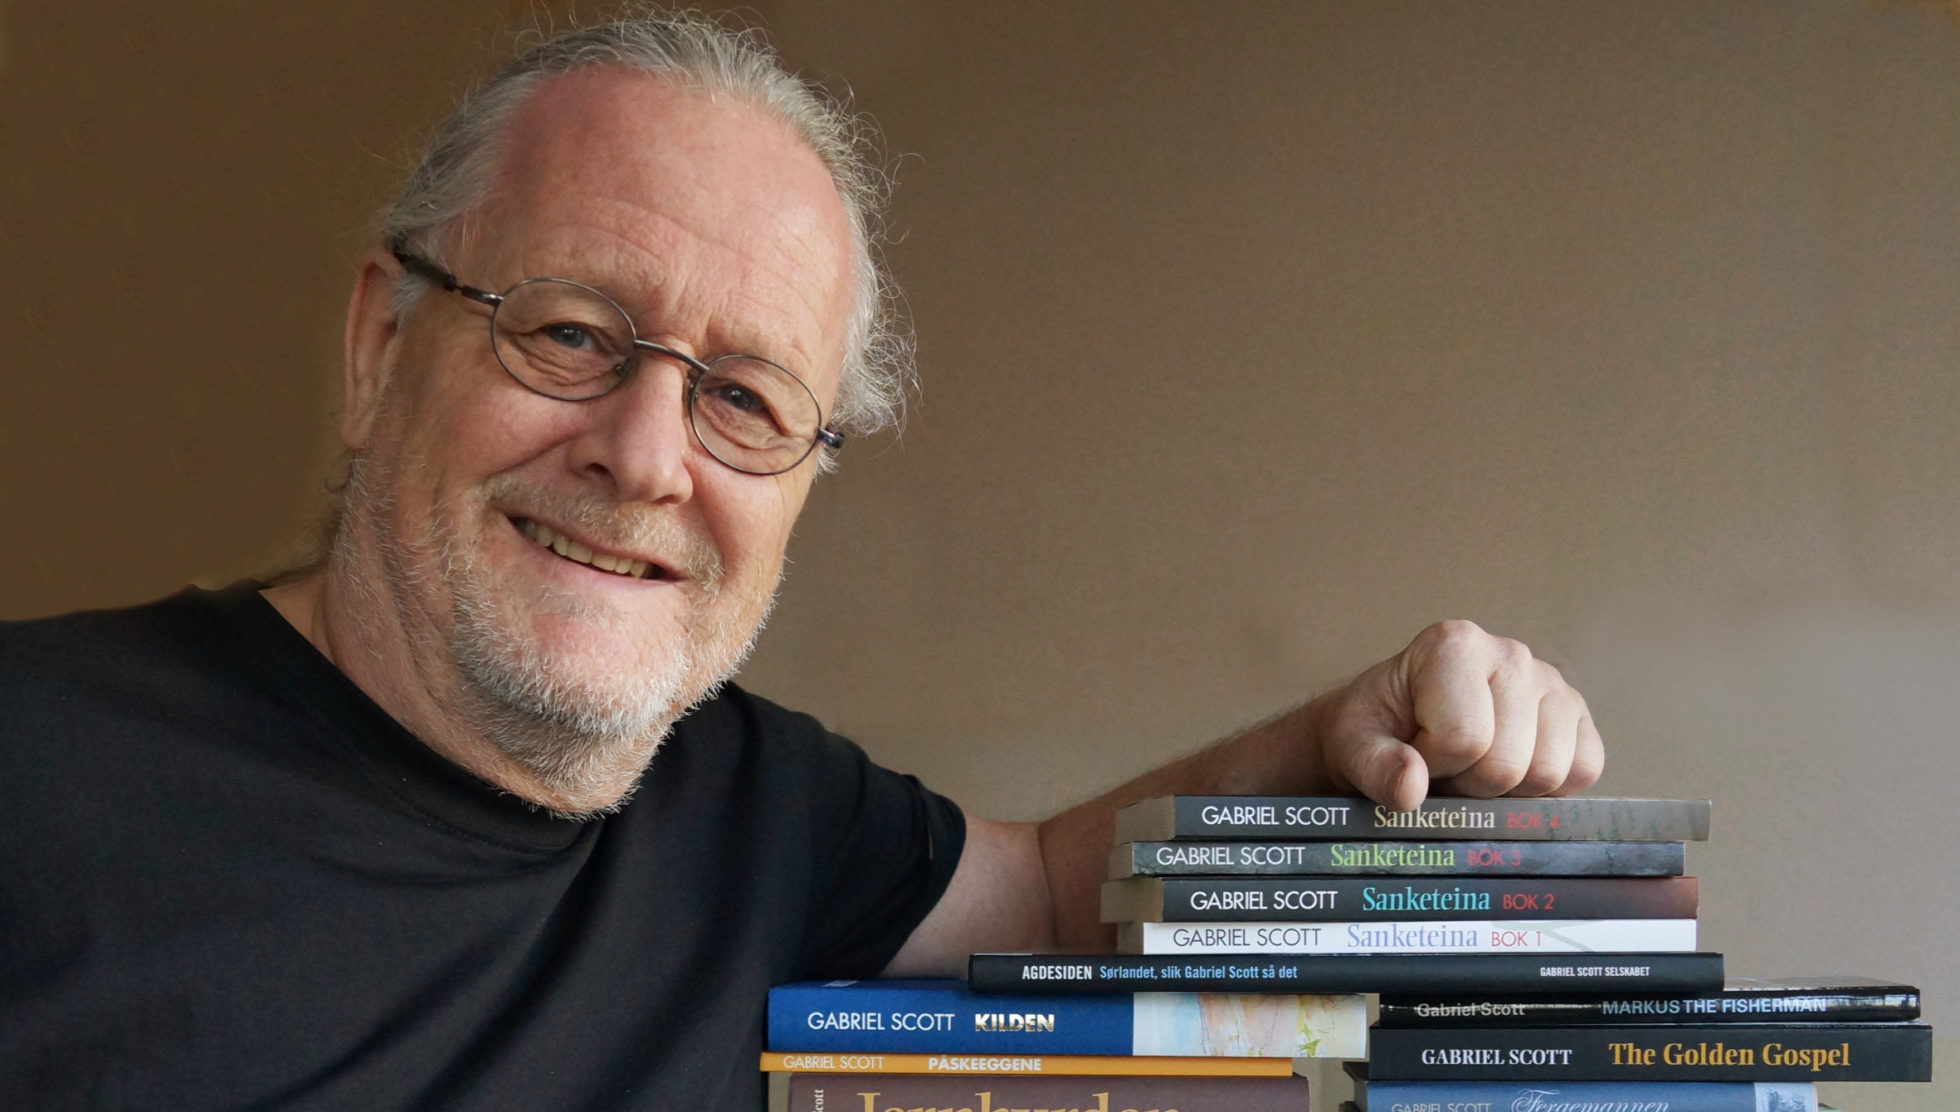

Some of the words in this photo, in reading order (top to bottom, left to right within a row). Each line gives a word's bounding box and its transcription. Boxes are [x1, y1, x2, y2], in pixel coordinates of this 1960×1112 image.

[1201, 805, 1279, 826] GABRIEL
[1285, 806, 1350, 826] SCOTT
[1374, 805, 1495, 829] Sanketeina
[1507, 812, 1543, 829] BOK
[1549, 813, 1560, 829] 4
[1156, 847, 1234, 866] GABRIEL
[1240, 846, 1305, 865] SCOTT
[1330, 843, 1455, 867] Sanketeina
[1467, 850, 1504, 867] BOK
[1511, 850, 1521, 866] 3
[1190, 891, 1268, 910] GABRIEL
[1273, 891, 1338, 910] SCOTT
[1362, 886, 1490, 911] Sanketeina
[1503, 894, 1538, 910] BOK
[1544, 894, 1555, 910] 2
[1173, 928, 1250, 947] GABRIEL
[1257, 928, 1321, 946] SCOTT
[1347, 923, 1478, 948] Sanketeina
[1491, 931, 1528, 947] BOK
[1534, 931, 1542, 947] 1
[1022, 965, 1093, 980] AGDESIDEN
[1100, 965, 1158, 981] Sørlandet,
[1161, 965, 1182, 979] slik
[1184, 965, 1226, 980] Gabriel
[1228, 965, 1259, 980] Scott
[1262, 965, 1276, 979] så
[1278, 965, 1298, 980] det
[1540, 967, 1575, 977] GABRIEL
[1577, 967, 1603, 977] SCOTT
[1604, 966, 1651, 977] SELSKABET
[1417, 1003, 1476, 1017] Gabriel
[1480, 1002, 1526, 1016] Scott
[1602, 1000, 1681, 1015] MARKUS
[1684, 999, 1717, 1014] THE
[1722, 998, 1827, 1014] FISHERMAN
[807, 1012, 886, 1031] GABRIEL
[890, 1013, 956, 1032] SCOTT
[974, 1013, 1055, 1033] KILDEN
[783, 1056, 837, 1069] GABRIEL
[839, 1056, 885, 1070] SCOTT
[927, 1055, 1042, 1071] PÅSKEEGGENE
[1421, 1049, 1505, 1065] GABRIEL
[1508, 1049, 1572, 1065] SCOTT
[1608, 1043, 1656, 1066] The
[1662, 1043, 1755, 1066] Golden
[1761, 1043, 1851, 1072] Gospel
[812, 1089, 825, 1112] cott
